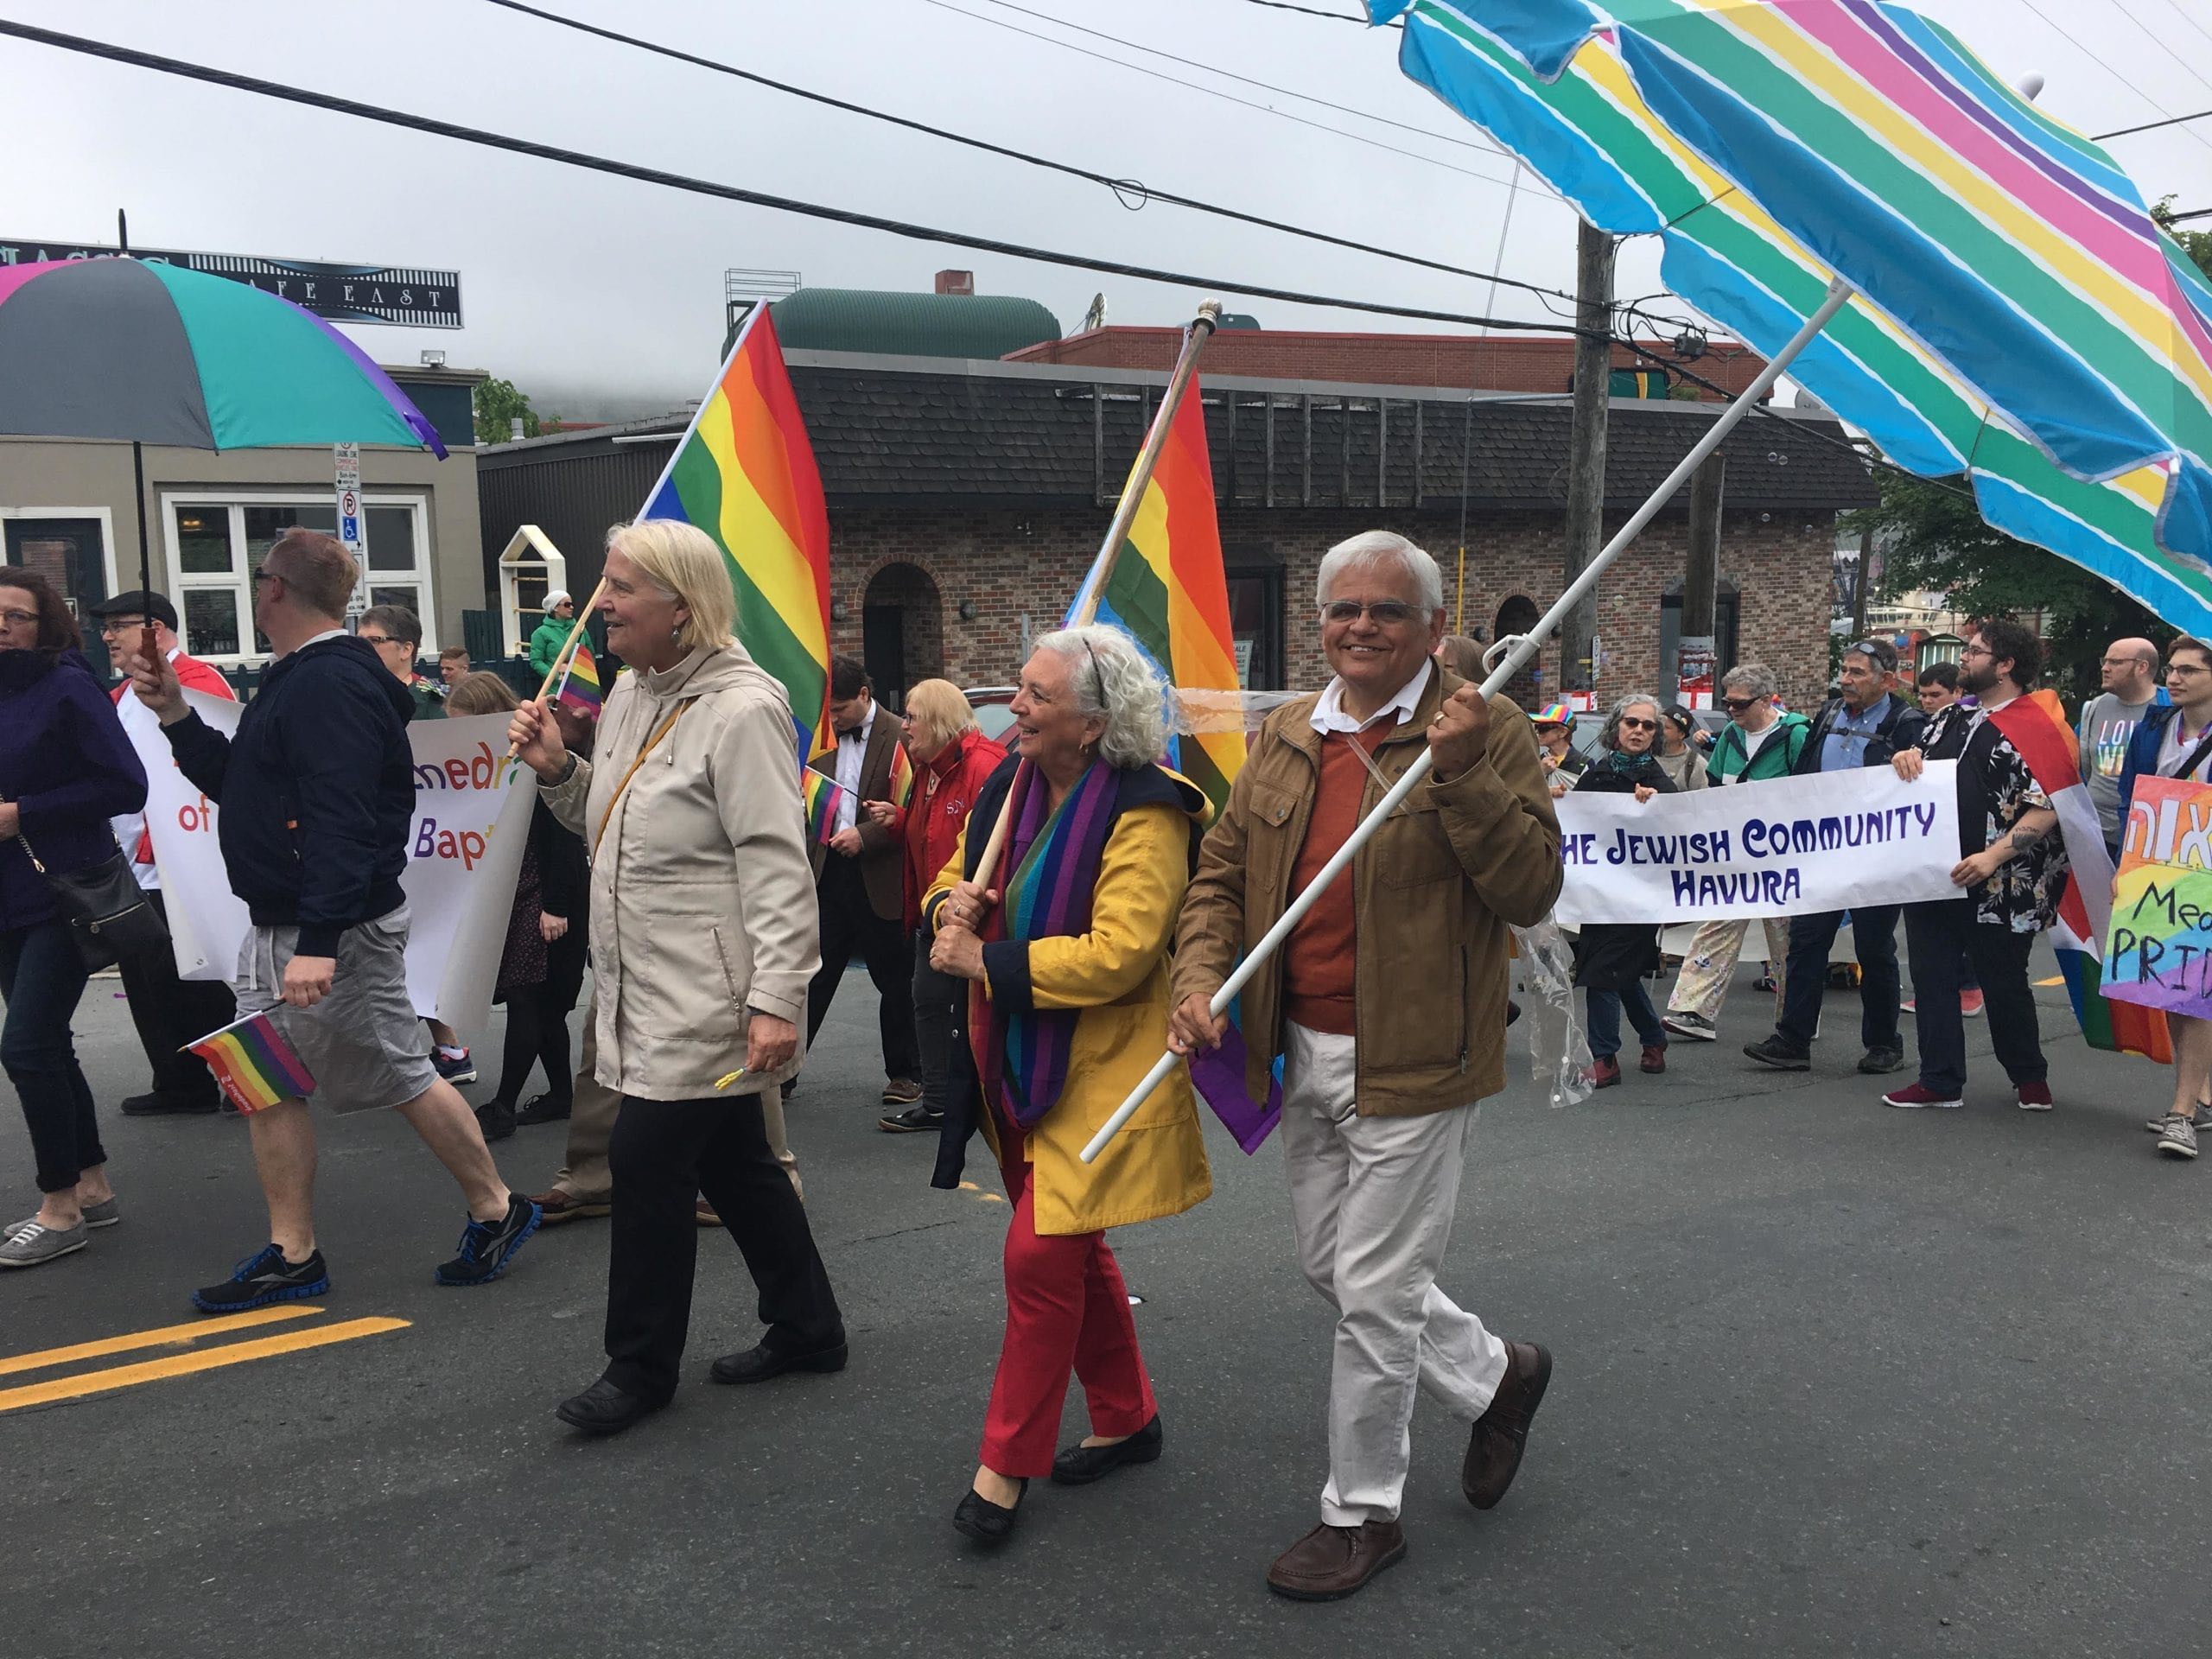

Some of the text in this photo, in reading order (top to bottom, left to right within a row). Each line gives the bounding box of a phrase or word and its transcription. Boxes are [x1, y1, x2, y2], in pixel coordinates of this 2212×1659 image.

[247, 278, 440, 307] AFE EAST
[178, 793, 210, 832] of
[414, 817, 495, 871] Bap
[1561, 802, 1936, 864] HE JEWISH COMMUNITY
[1671, 868, 1801, 907] HAVURA
